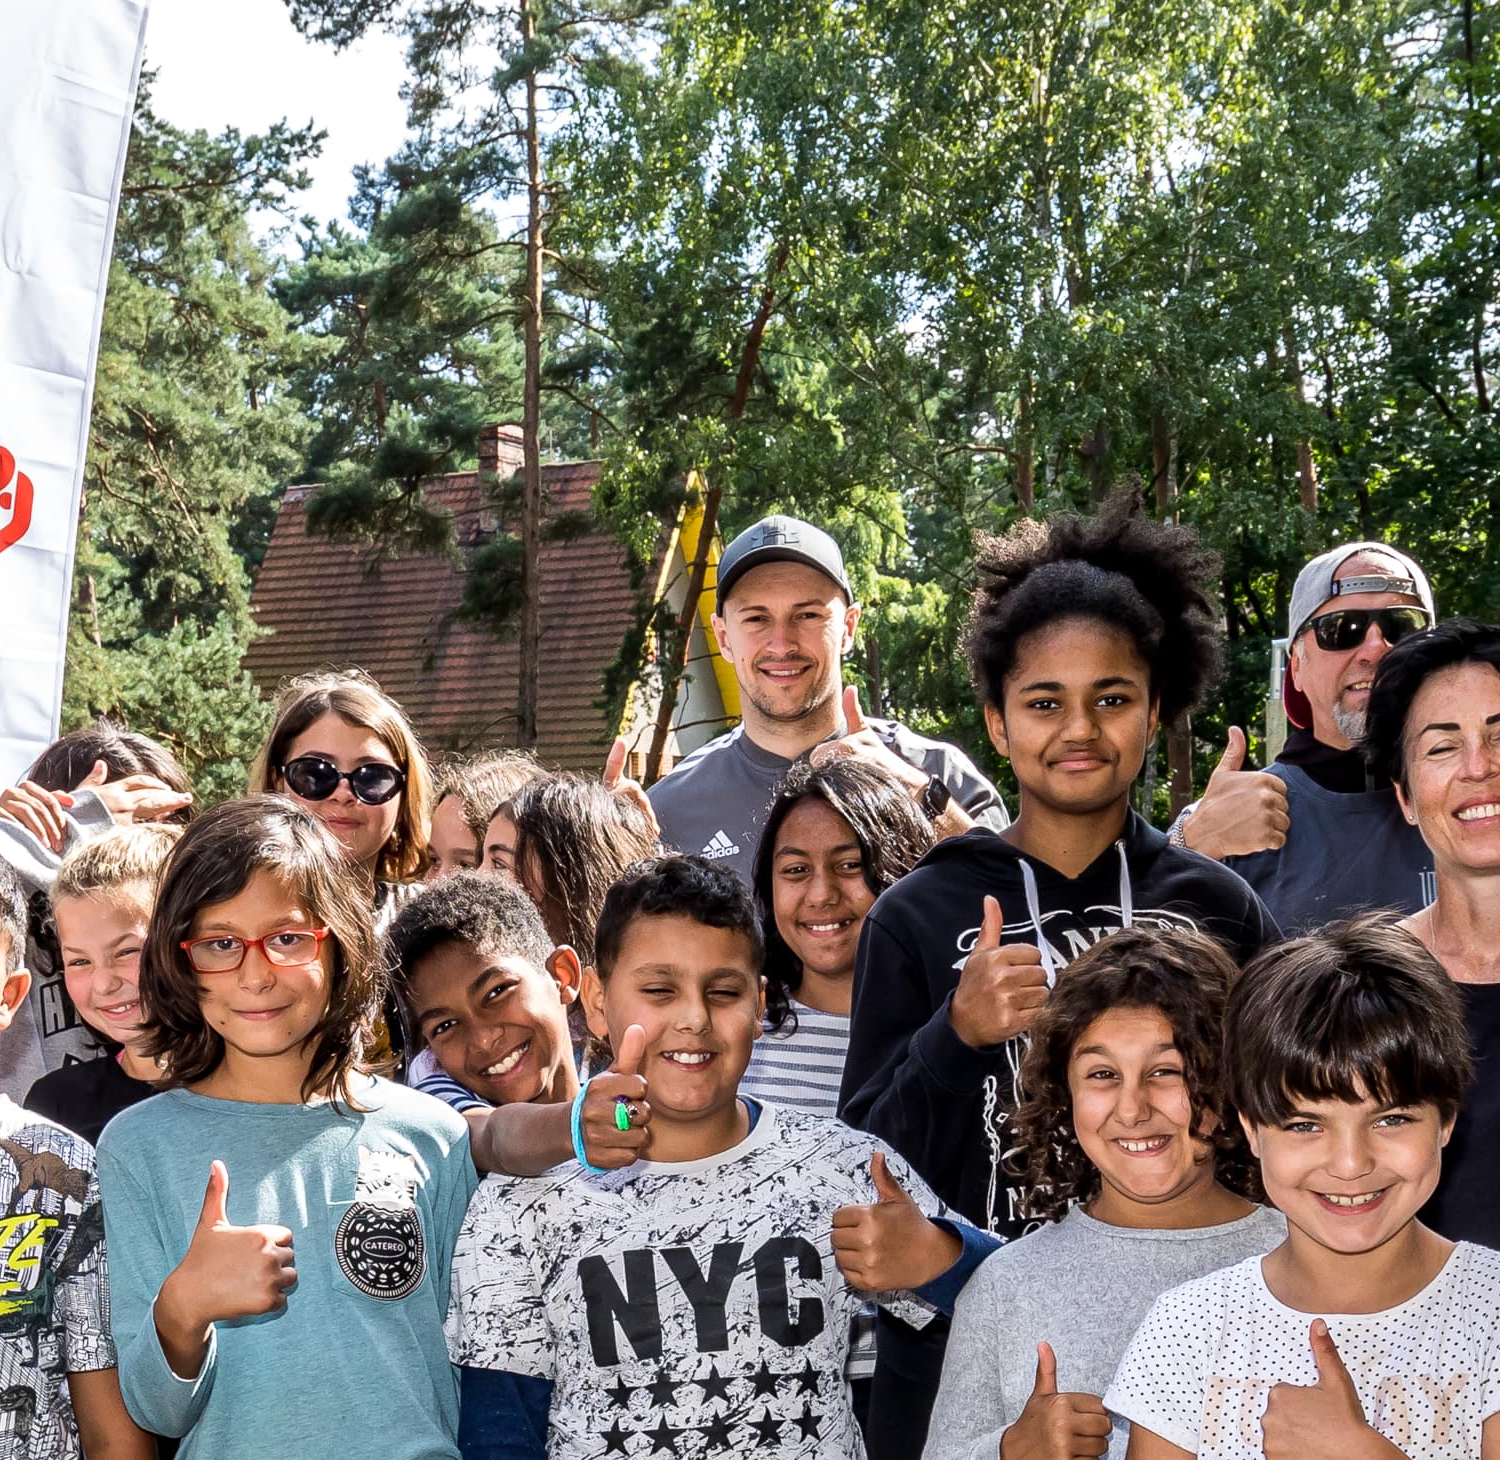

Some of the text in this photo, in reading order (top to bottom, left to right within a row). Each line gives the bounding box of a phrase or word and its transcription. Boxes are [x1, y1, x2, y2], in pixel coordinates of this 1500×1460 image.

[365, 1241, 404, 1252] CATEREO
[578, 1236, 825, 1368] NYC
[1202, 1372, 1470, 1445] TAY
